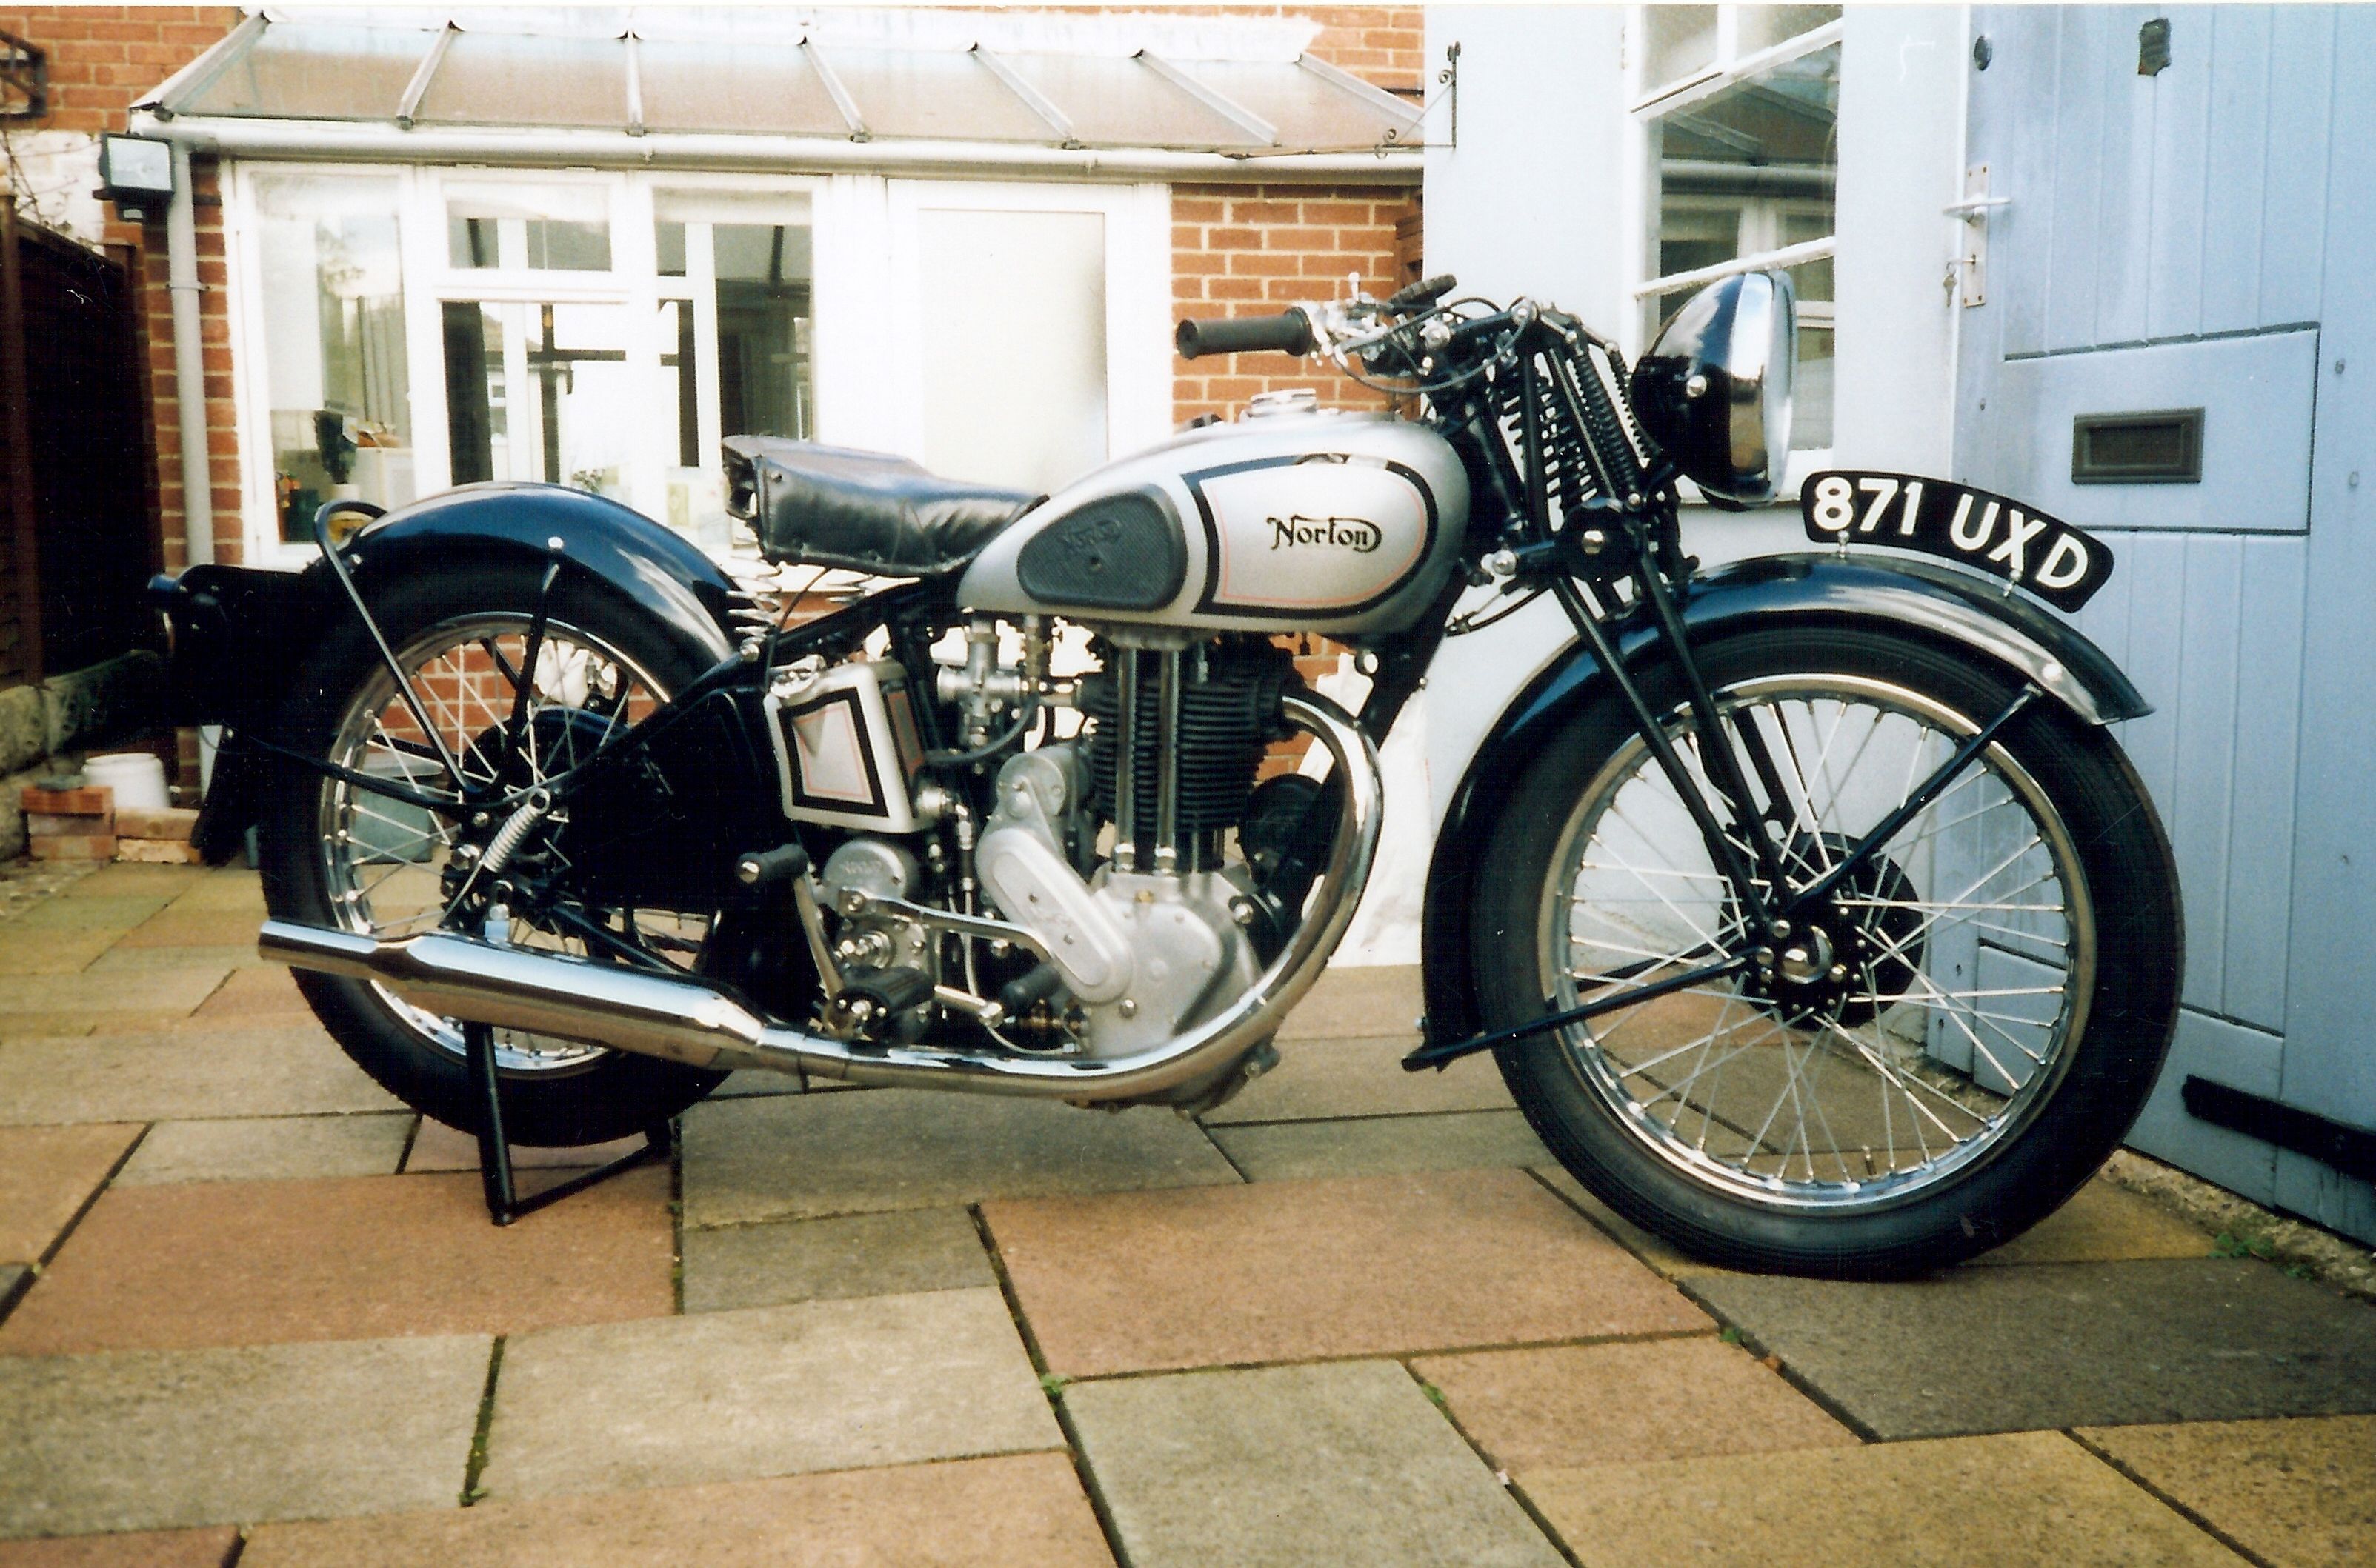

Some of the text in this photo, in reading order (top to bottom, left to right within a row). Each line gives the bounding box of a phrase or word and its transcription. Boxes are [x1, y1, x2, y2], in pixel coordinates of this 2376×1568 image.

[1265, 513, 1382, 553] Norton
[1813, 476, 2089, 589] 871 UXD
